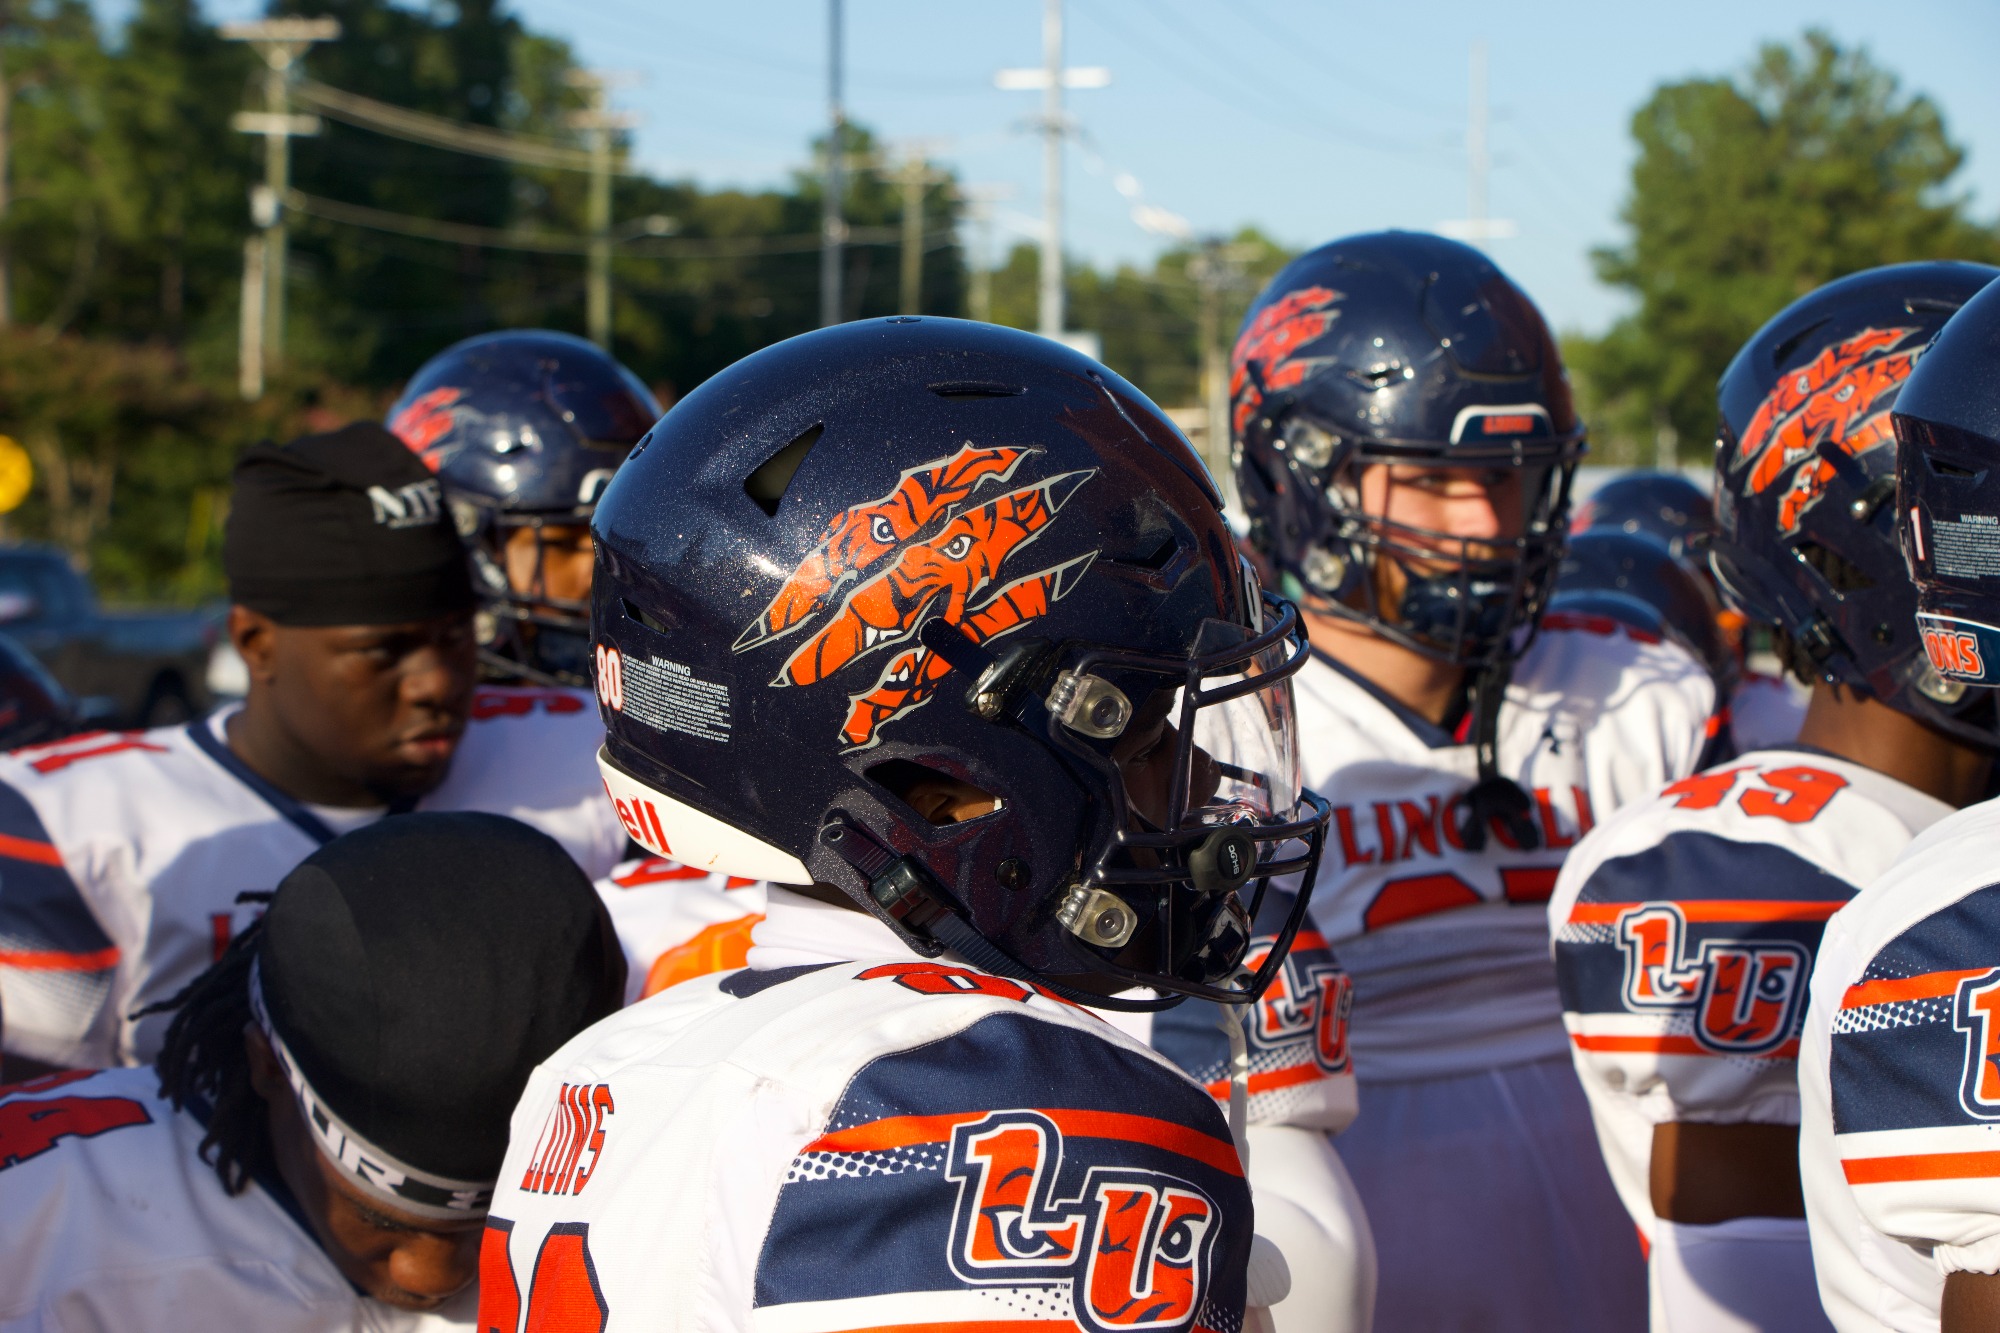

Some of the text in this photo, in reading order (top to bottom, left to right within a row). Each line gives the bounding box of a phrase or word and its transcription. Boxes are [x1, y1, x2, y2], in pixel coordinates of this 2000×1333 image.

[1960, 514, 1999, 525] WARNING
[596, 644, 623, 711] 80
[651, 655, 692, 676] WARNING
[1615, 900, 1812, 1056] LU
[519, 1082, 615, 1197] LIONS
[944, 1109, 1223, 1333] LU
